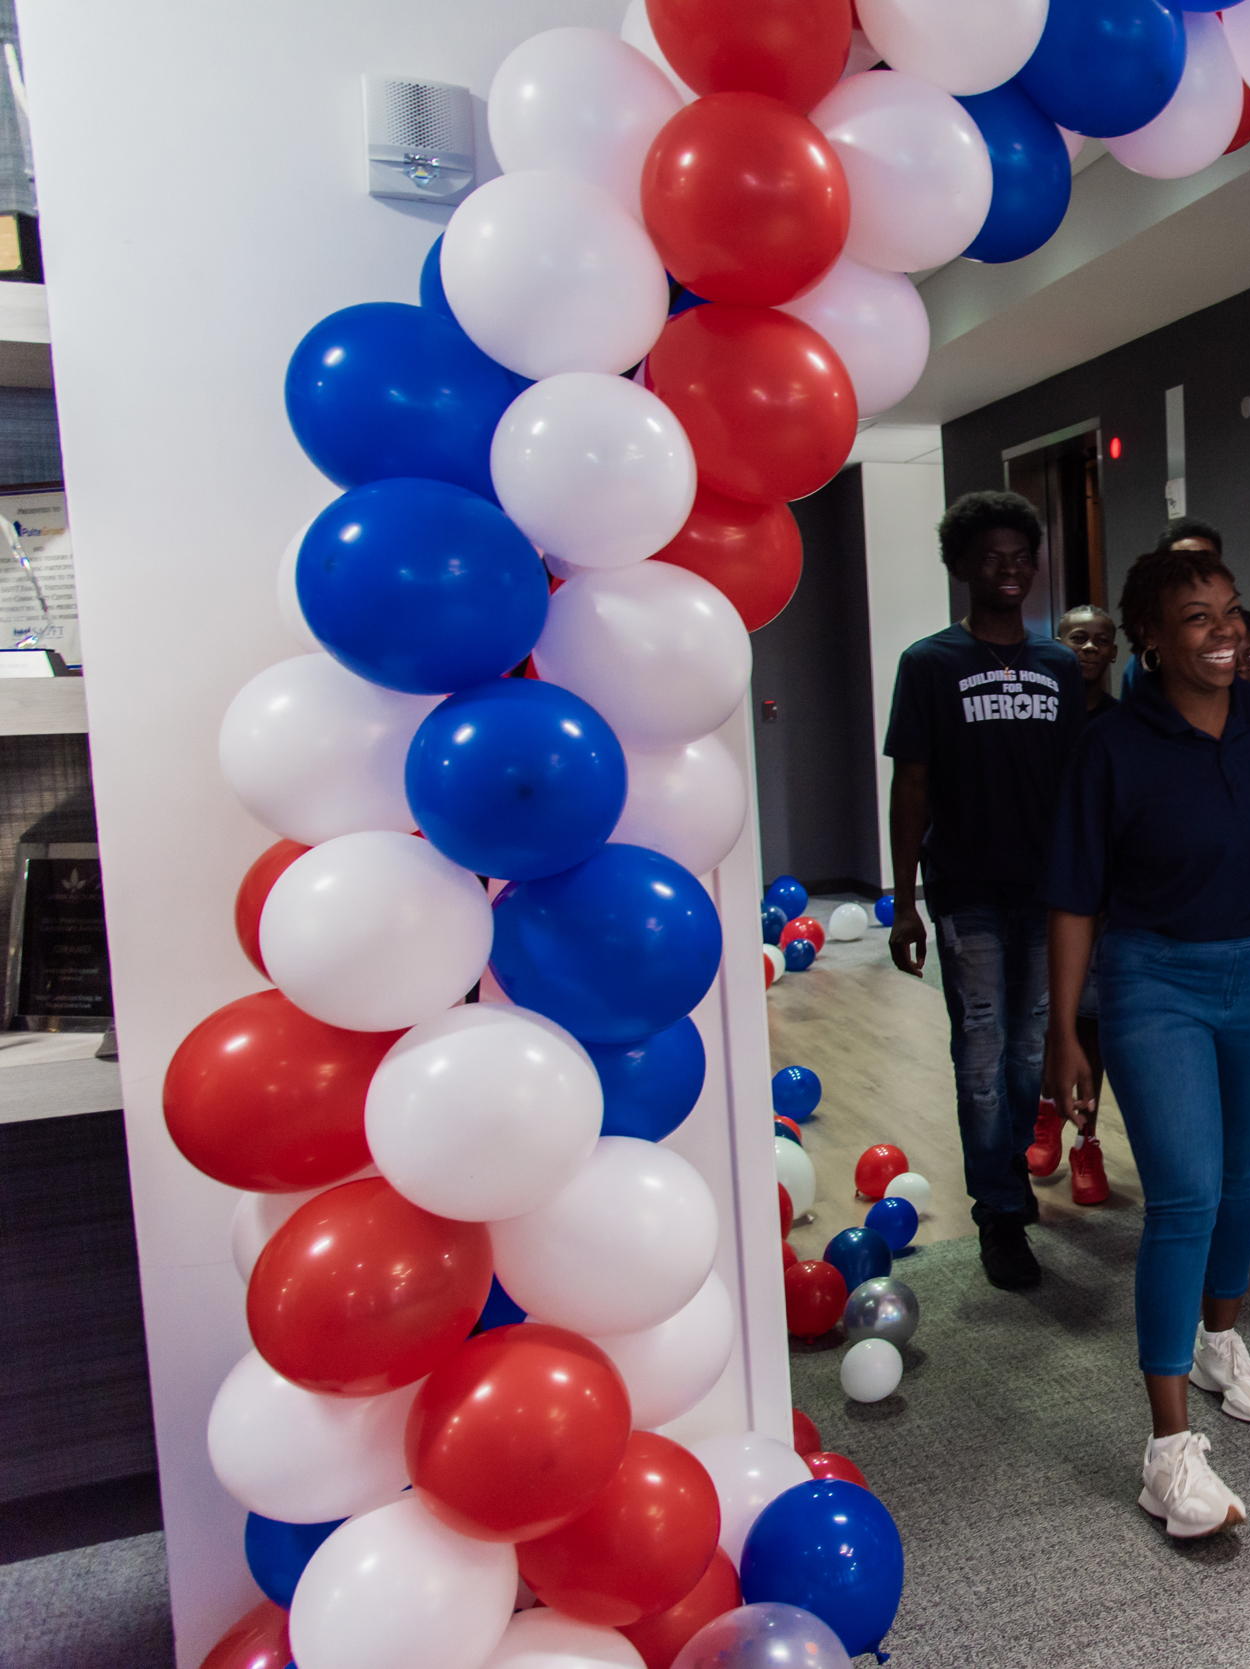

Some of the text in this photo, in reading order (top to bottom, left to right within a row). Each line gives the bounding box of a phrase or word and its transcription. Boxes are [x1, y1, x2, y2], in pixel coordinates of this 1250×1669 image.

[959, 670, 1059, 692] BUILDING HOMES
[1002, 683, 1023, 693] FOR
[962, 694, 1059, 723] HEROES
